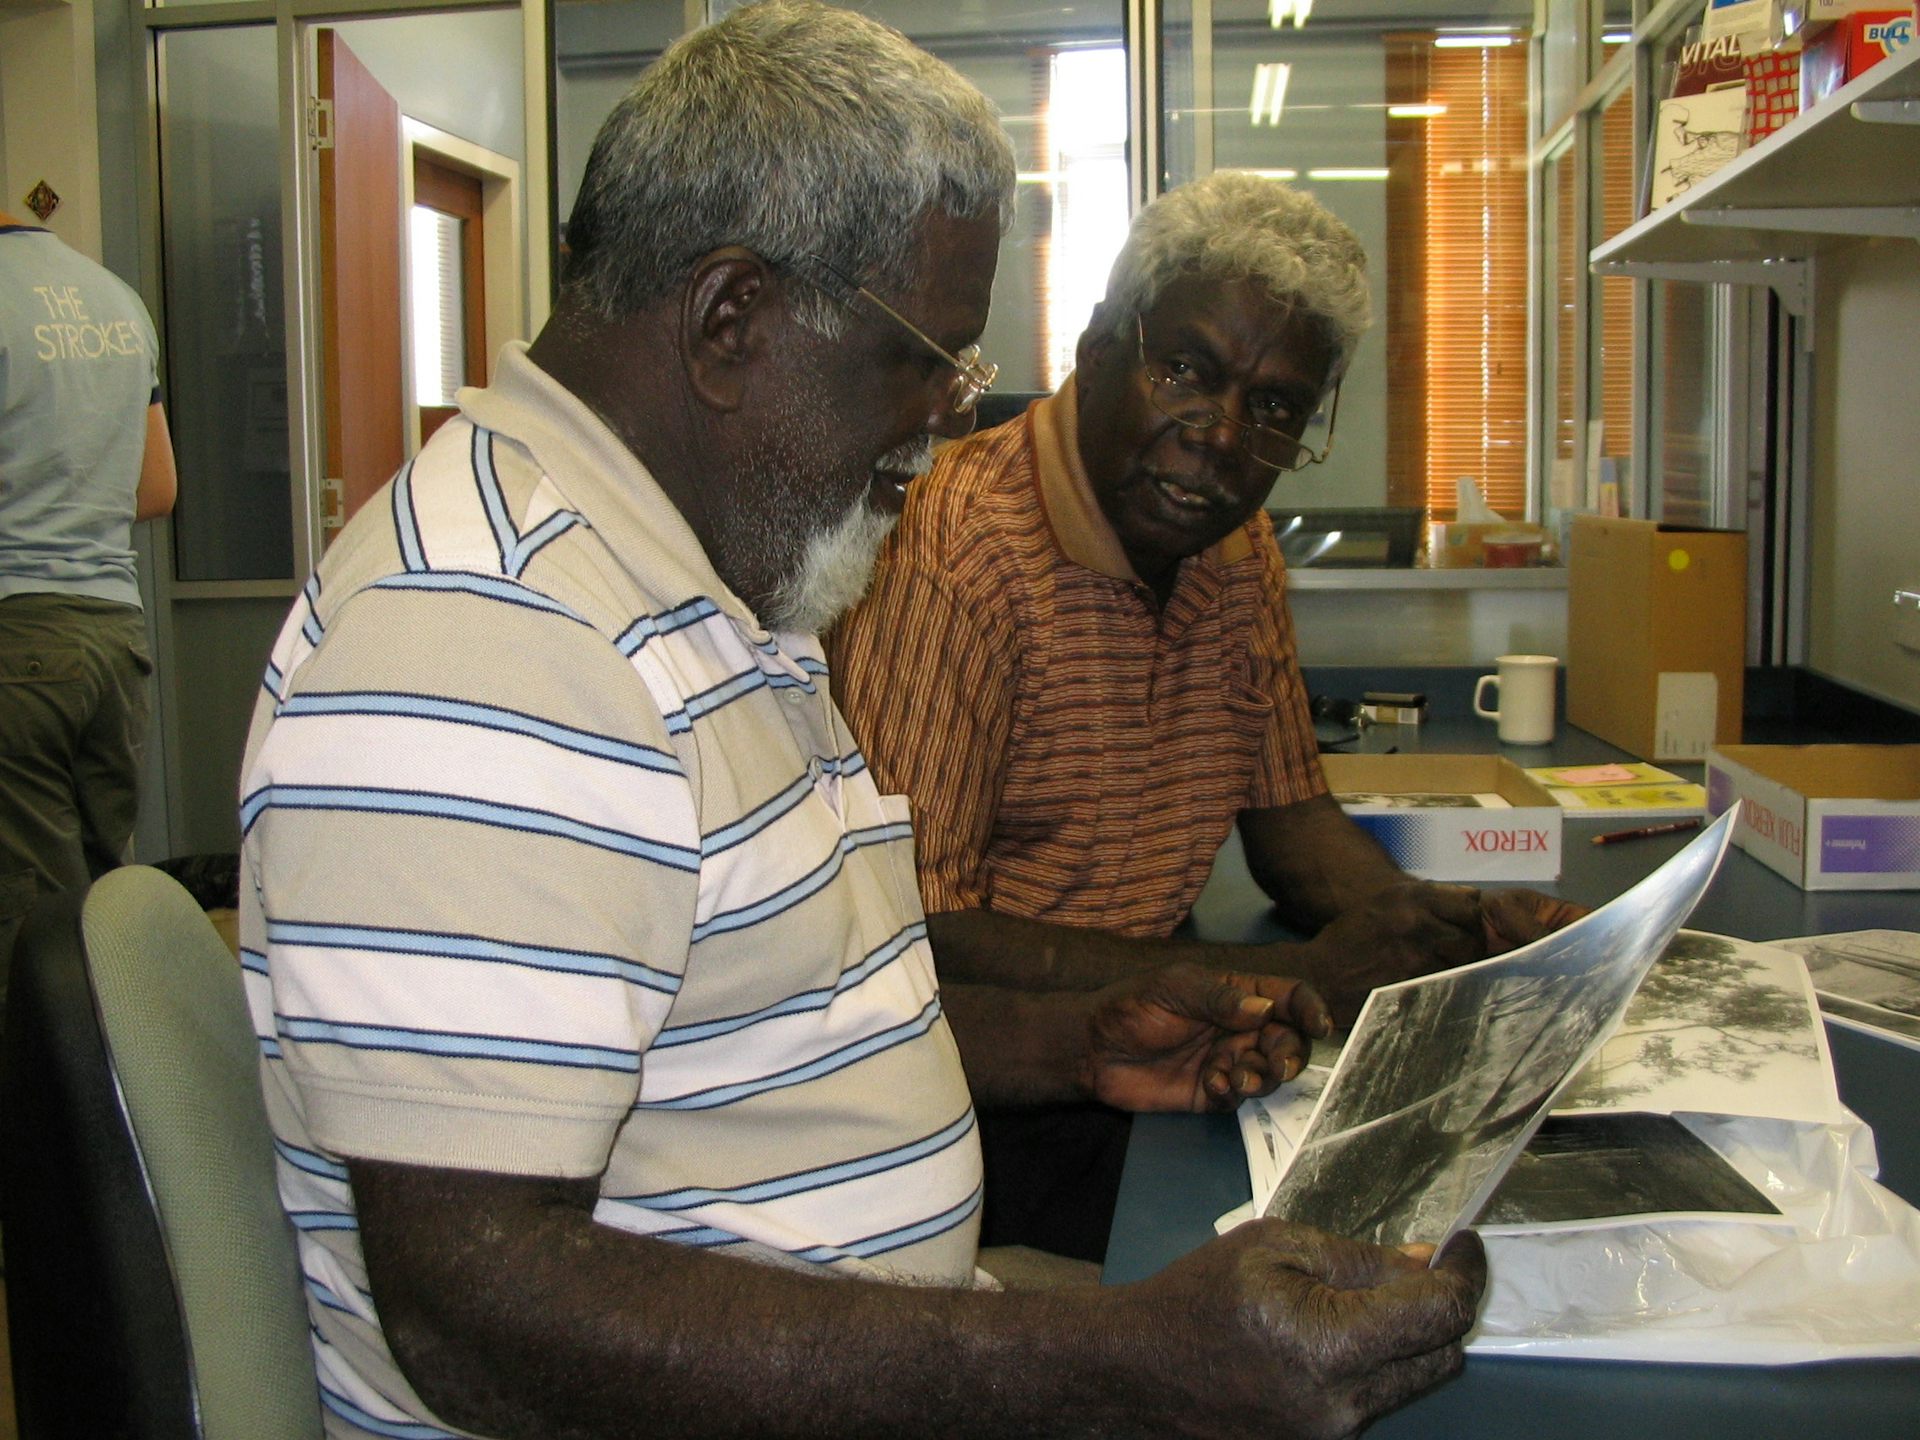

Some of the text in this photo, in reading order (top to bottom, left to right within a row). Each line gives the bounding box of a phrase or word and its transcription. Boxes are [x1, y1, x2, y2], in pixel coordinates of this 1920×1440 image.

[1681, 33, 1740, 65] VITAL
[33, 286, 89, 321] THE
[34, 321, 145, 361] STROKES
[1464, 829, 1549, 852] XEROX
